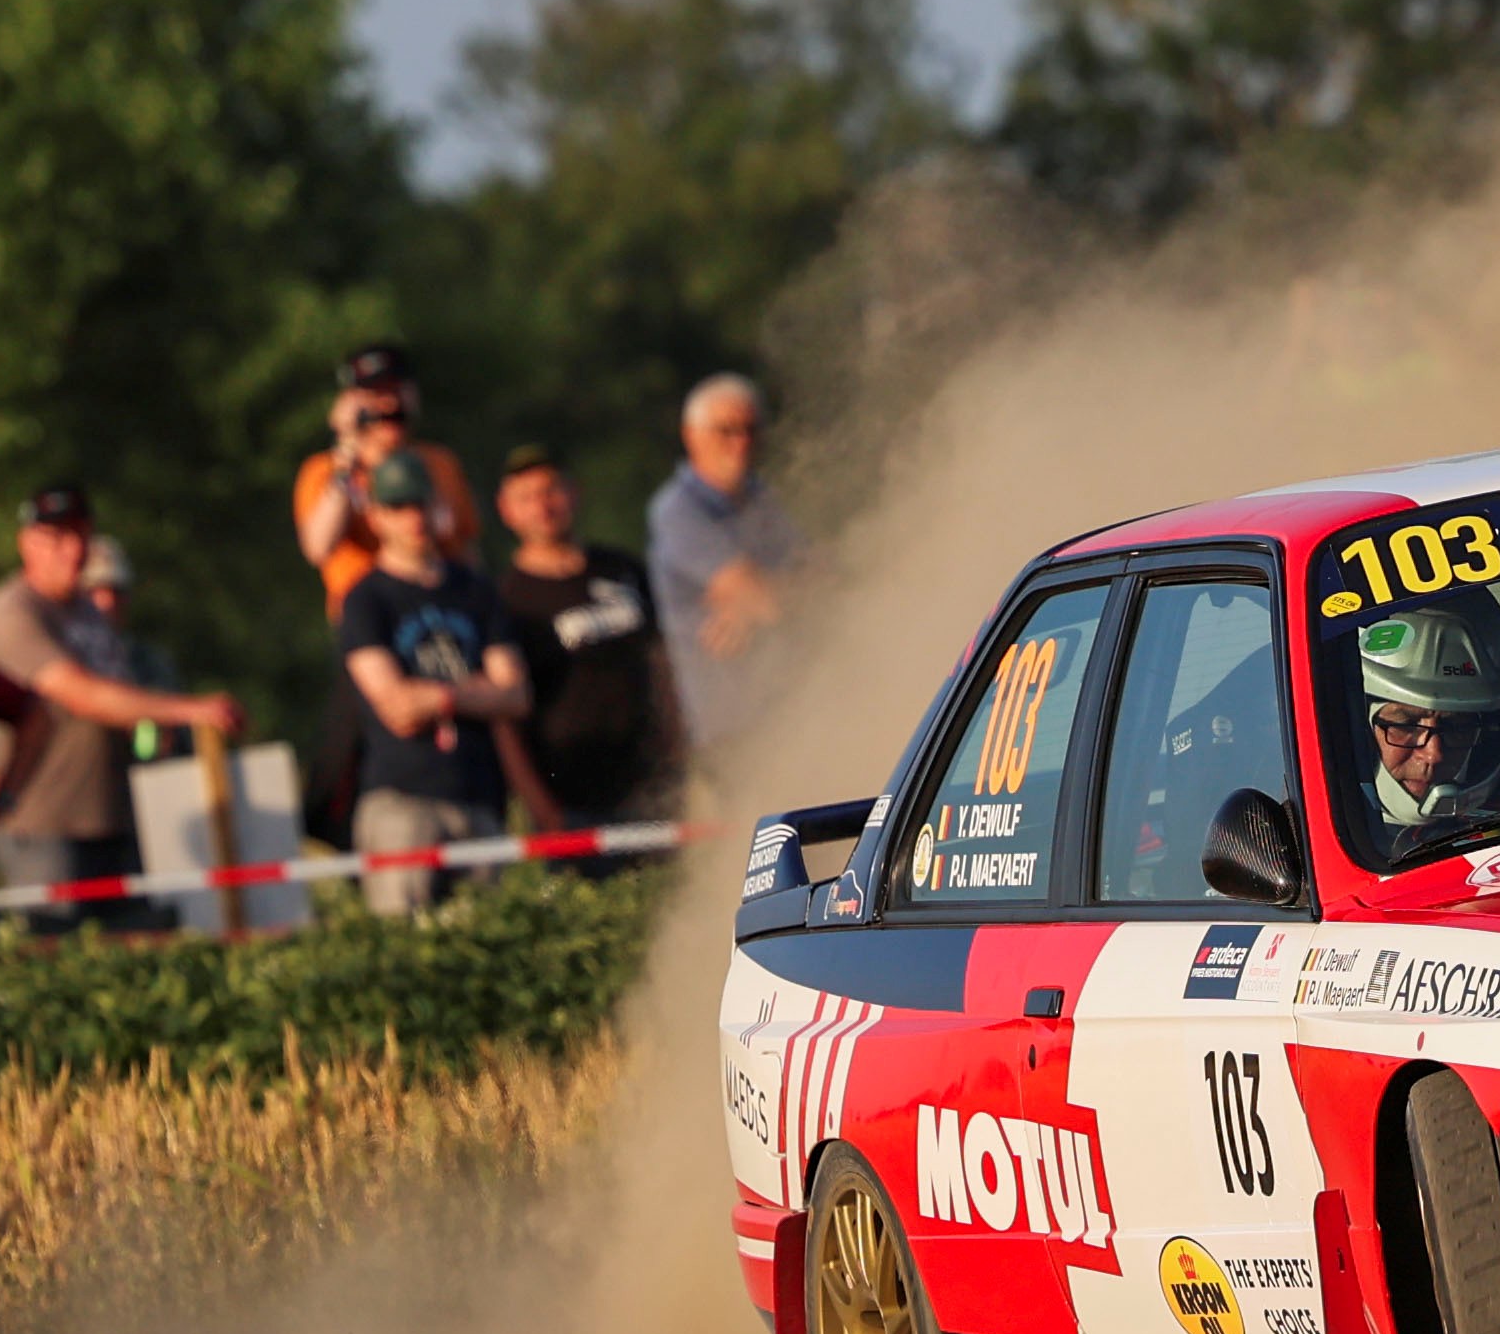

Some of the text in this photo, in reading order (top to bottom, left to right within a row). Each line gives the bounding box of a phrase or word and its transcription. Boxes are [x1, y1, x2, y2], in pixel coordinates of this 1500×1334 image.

[973, 637, 1057, 796] 103
[958, 804, 1022, 838] Y. DEWULF
[949, 853, 1037, 888] PJ. MAEYAERT
[1206, 942, 1247, 964] ardeca
[1315, 948, 1361, 972] Y. Dewulf
[1307, 981, 1367, 1012] PJ. Maeyaert
[1203, 1050, 1275, 1197] 103
[917, 1103, 1112, 1249] MOTUL
[1224, 1258, 1256, 1289] THE
[1171, 1282, 1231, 1315] KROON
